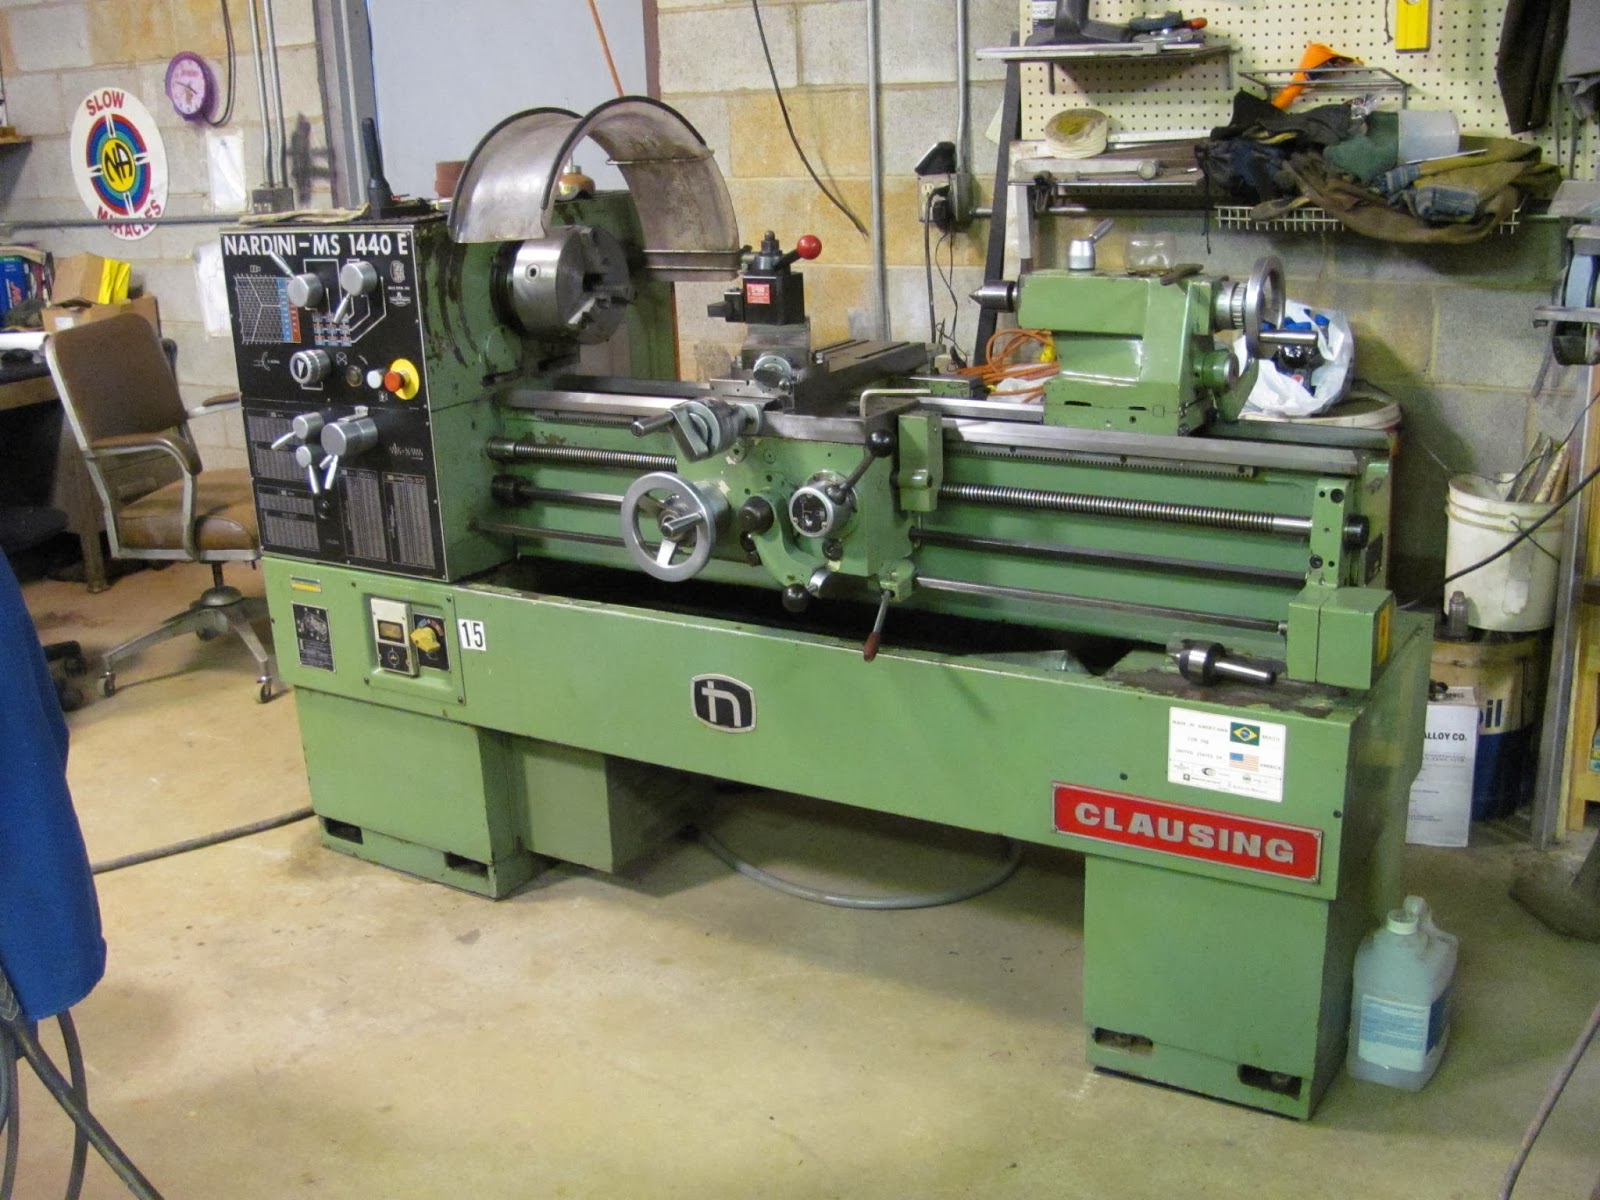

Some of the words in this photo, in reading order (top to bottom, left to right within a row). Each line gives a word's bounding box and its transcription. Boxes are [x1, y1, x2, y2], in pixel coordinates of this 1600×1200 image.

[86, 90, 125, 117] SLOW
[349, 233, 392, 255] 1440
[397, 233, 408, 255] E
[461, 620, 484, 648] 15
[1452, 732, 1468, 741] CO.
[1074, 802, 1295, 865] CLAUSING
